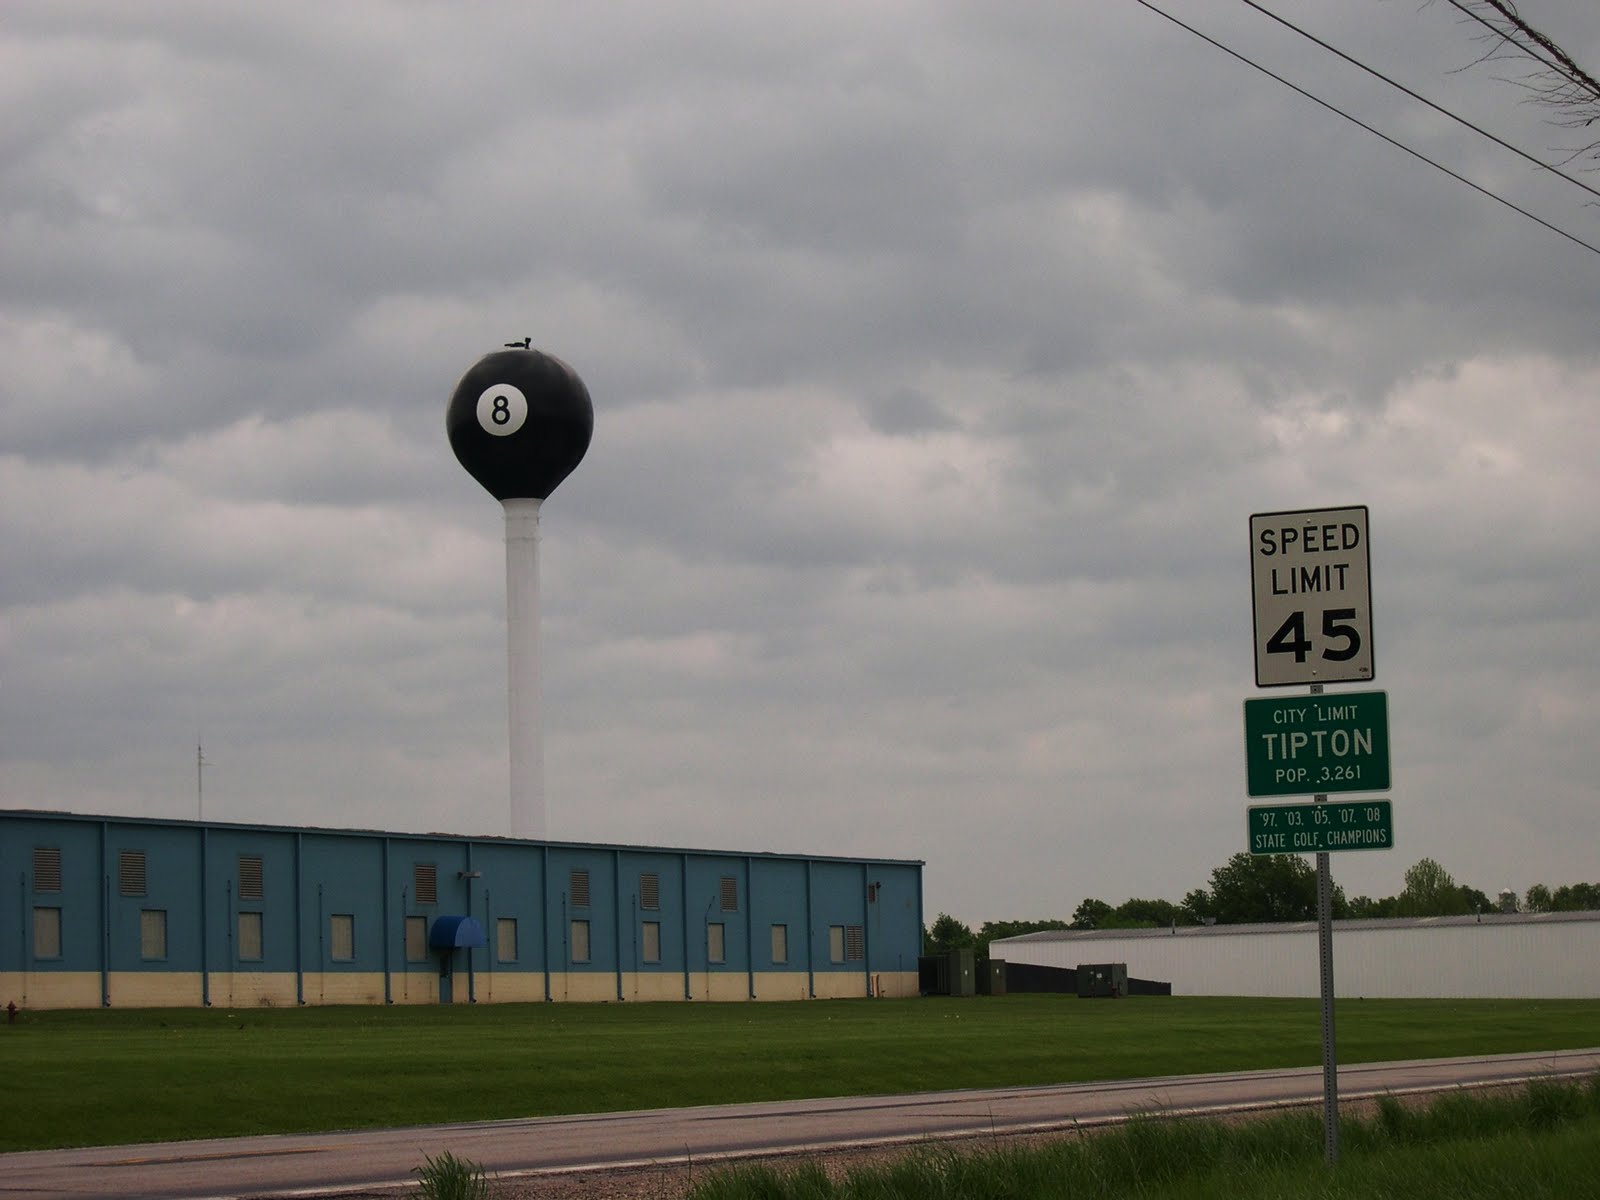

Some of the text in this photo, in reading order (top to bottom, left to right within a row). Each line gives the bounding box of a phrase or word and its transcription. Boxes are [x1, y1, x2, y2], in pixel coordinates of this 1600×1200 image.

[491, 395, 511, 425] 8
[1259, 523, 1360, 556] SPEED
[1271, 563, 1349, 595] LIMIT
[1266, 608, 1361, 663] 45
[1273, 705, 1358, 724] CITY LIMIT
[1262, 728, 1372, 760] TIPTON
[1276, 767, 1310, 783] POP.
[1255, 828, 1387, 849] STATE GOLF CHAMPIONS
